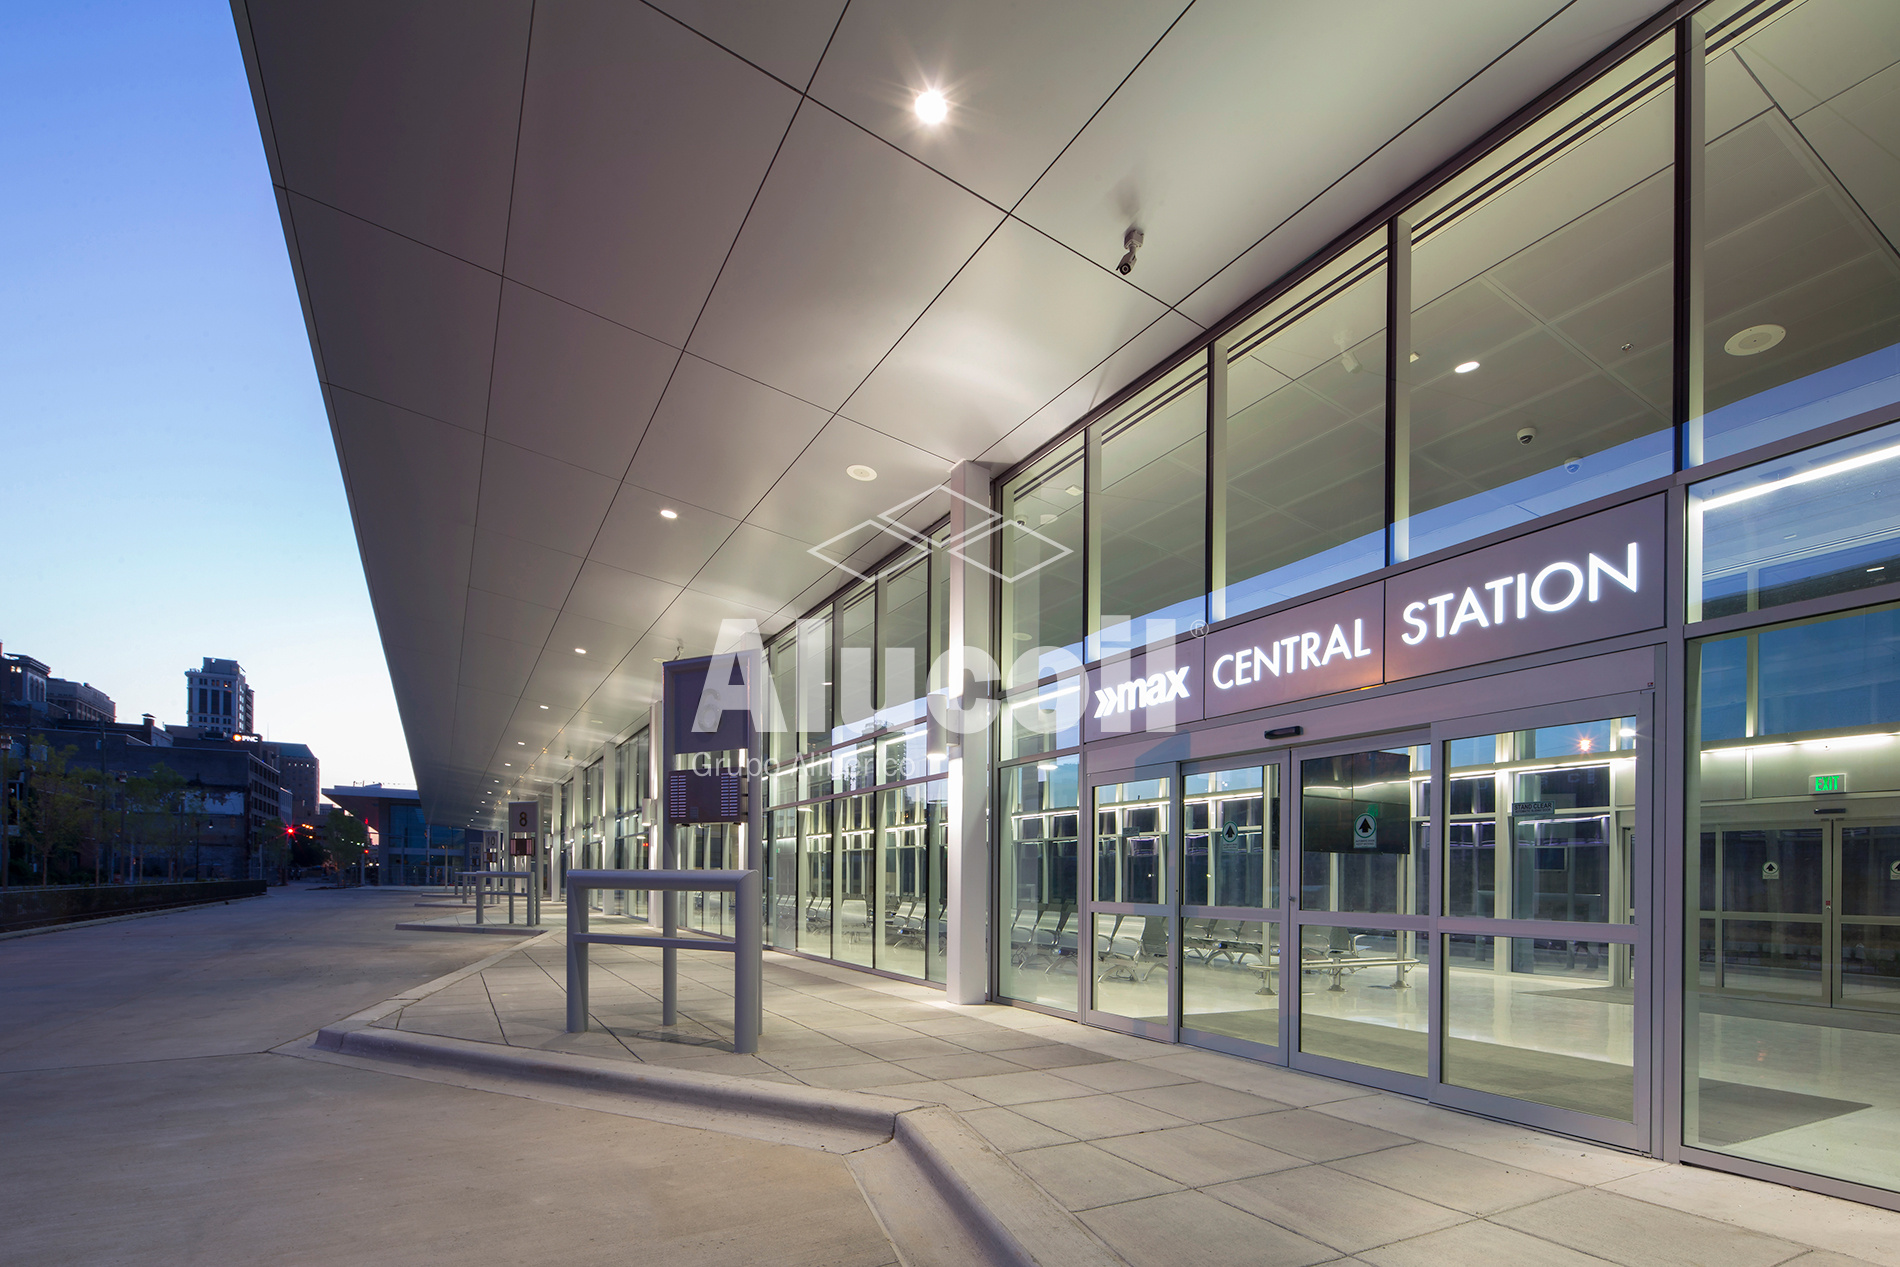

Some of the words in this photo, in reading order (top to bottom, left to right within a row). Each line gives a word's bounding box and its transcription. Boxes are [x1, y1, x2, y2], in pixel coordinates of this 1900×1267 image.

[1212, 618, 1371, 690] CENTRAL
[1401, 542, 1638, 646] STATION
[1117, 666, 1191, 713] max
[697, 688, 722, 734] 6
[242, 735, 258, 743] PNC
[1815, 776, 1840, 791] EXIT
[519, 811, 527, 827] 8
[488, 836, 496, 846] 10
